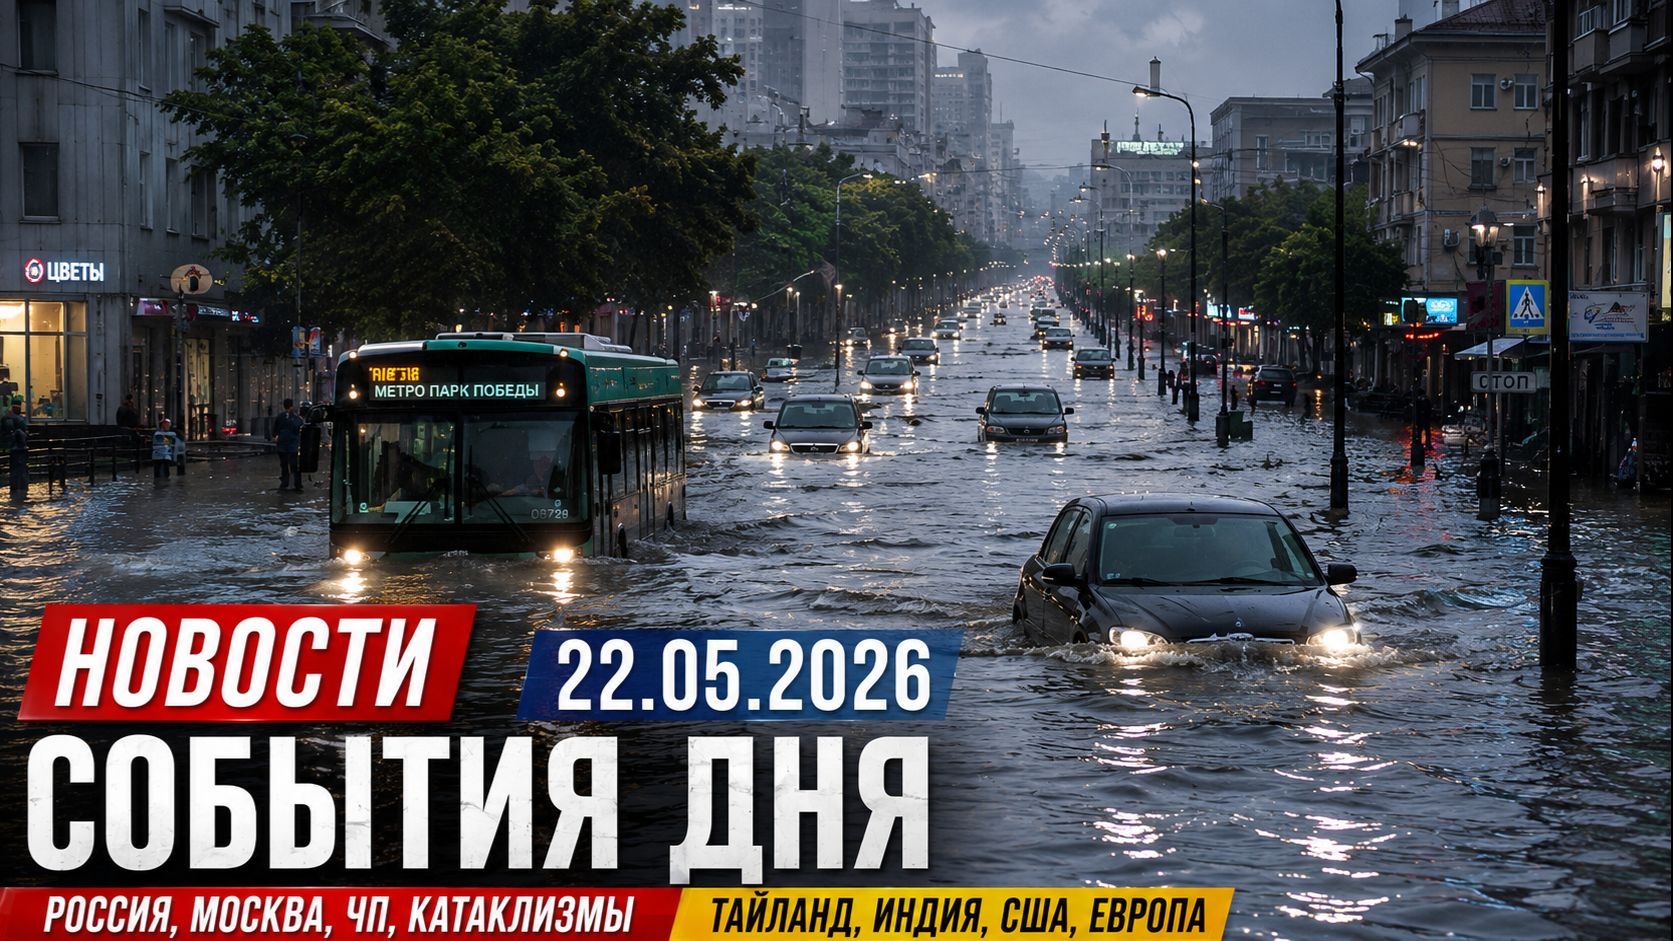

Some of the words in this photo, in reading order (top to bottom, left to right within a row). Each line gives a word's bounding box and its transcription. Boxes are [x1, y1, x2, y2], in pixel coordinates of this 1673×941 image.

[47, 261, 104, 283] ЦВЕТЫ
[1479, 375, 1528, 389] СТОП
[375, 384, 425, 398] МЕТРО
[429, 384, 469, 397] ПАРК
[473, 384, 539, 399] ПОБЕДЫ
